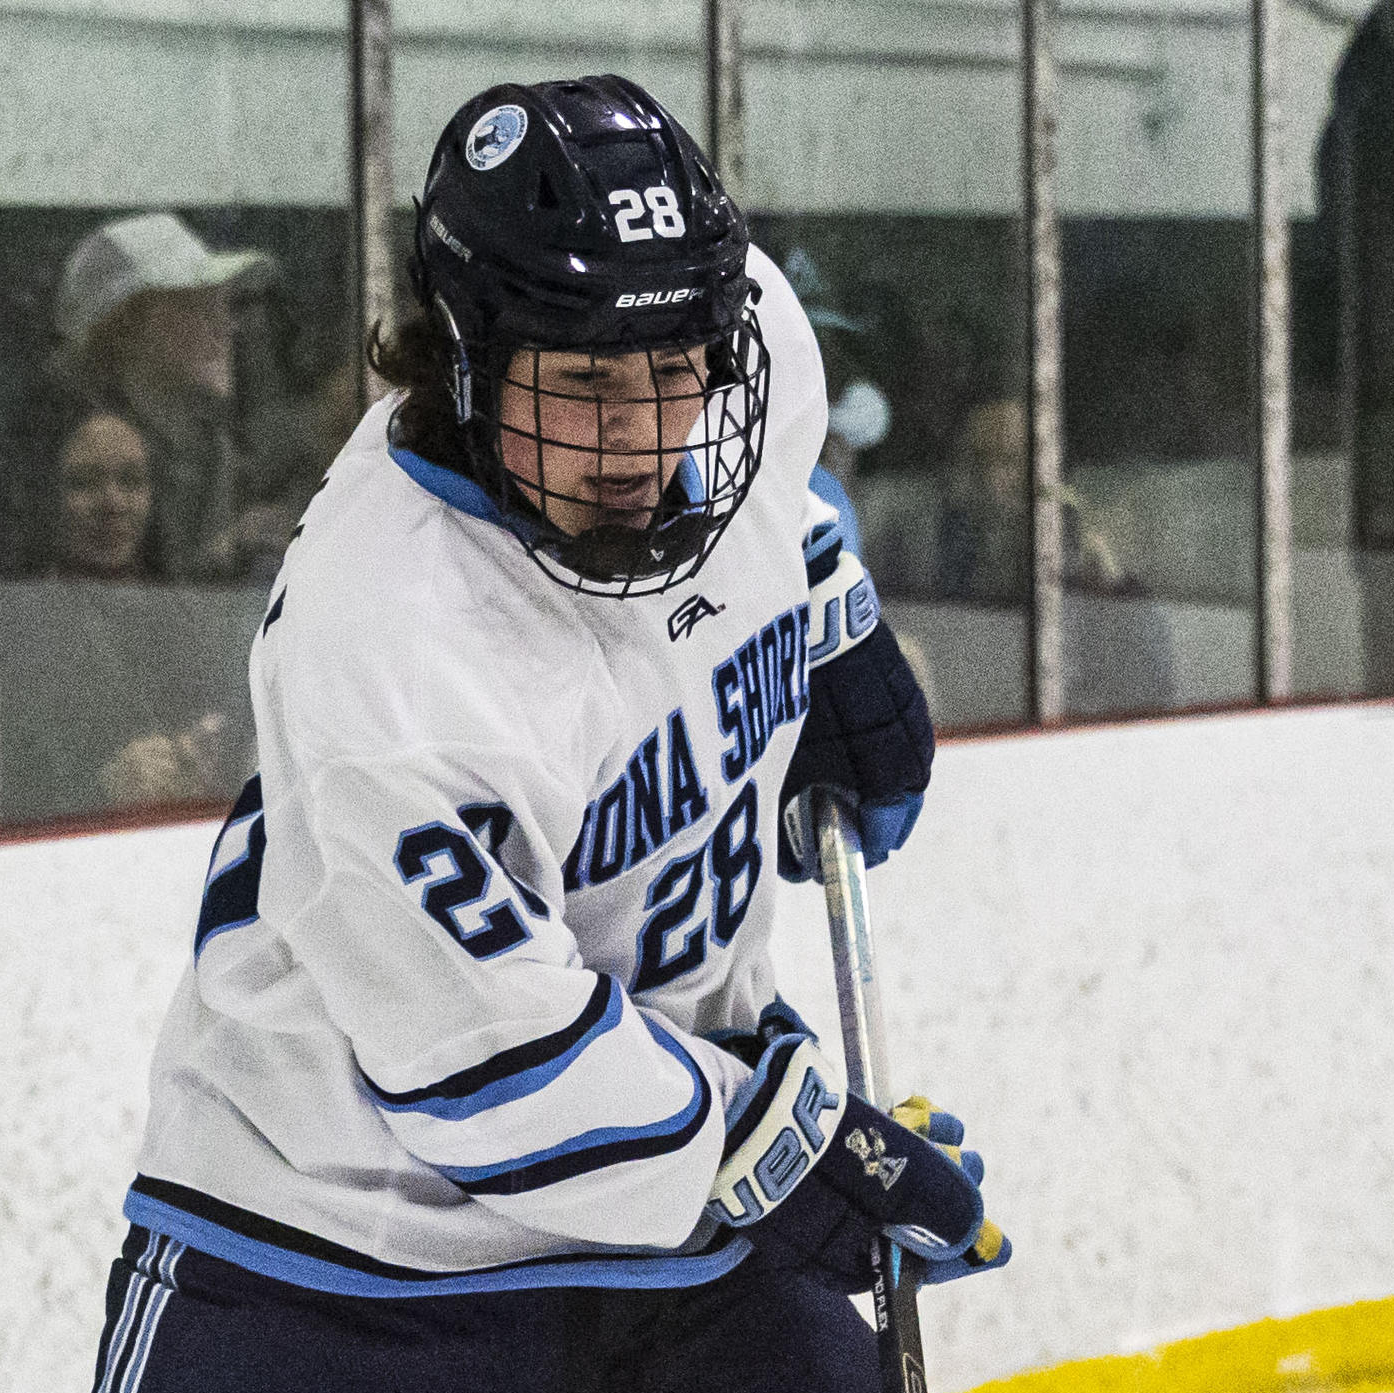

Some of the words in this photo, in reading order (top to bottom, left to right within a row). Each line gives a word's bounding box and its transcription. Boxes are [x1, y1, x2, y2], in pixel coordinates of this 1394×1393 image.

[608, 187, 686, 242] 28
[628, 777, 763, 994] 28
[877, 1295, 888, 1332] FLEX
